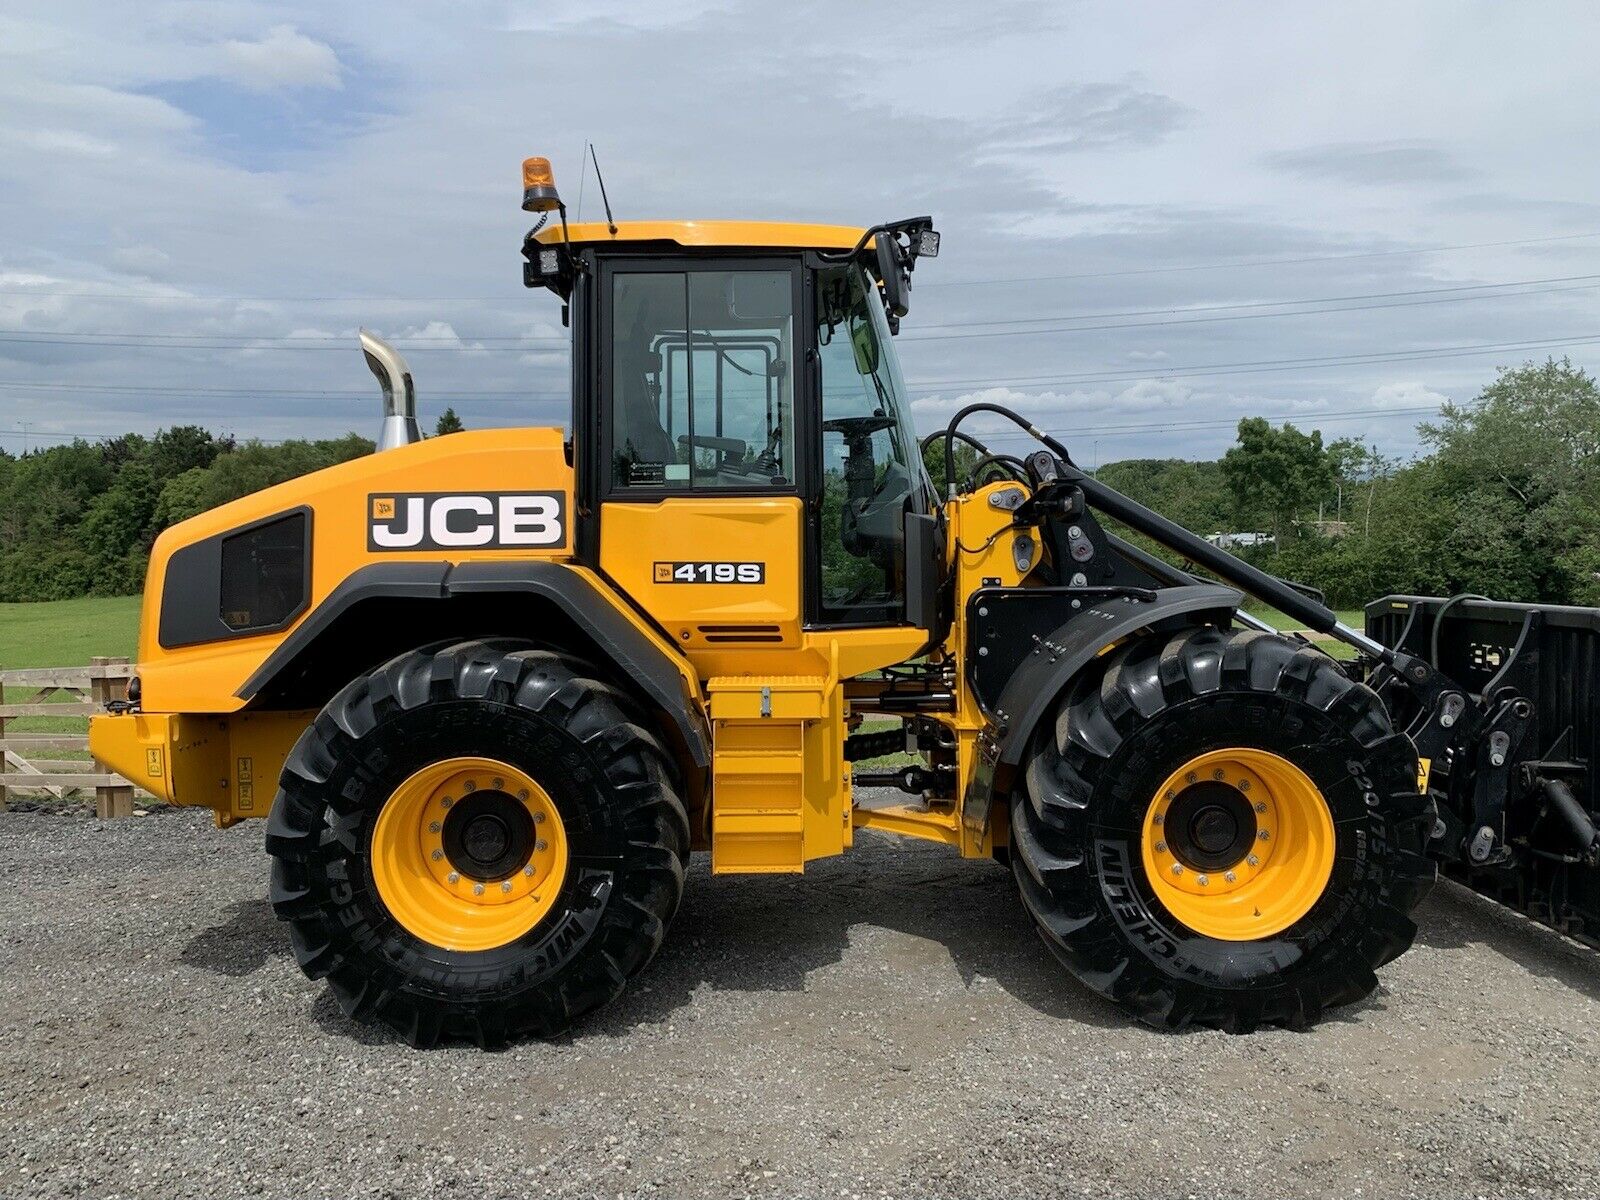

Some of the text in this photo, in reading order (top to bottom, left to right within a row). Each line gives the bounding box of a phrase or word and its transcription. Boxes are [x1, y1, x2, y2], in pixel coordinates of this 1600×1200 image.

[373, 495, 562, 547] JCB
[674, 563, 761, 583] 419S
[1346, 760, 1387, 856] 620/75
